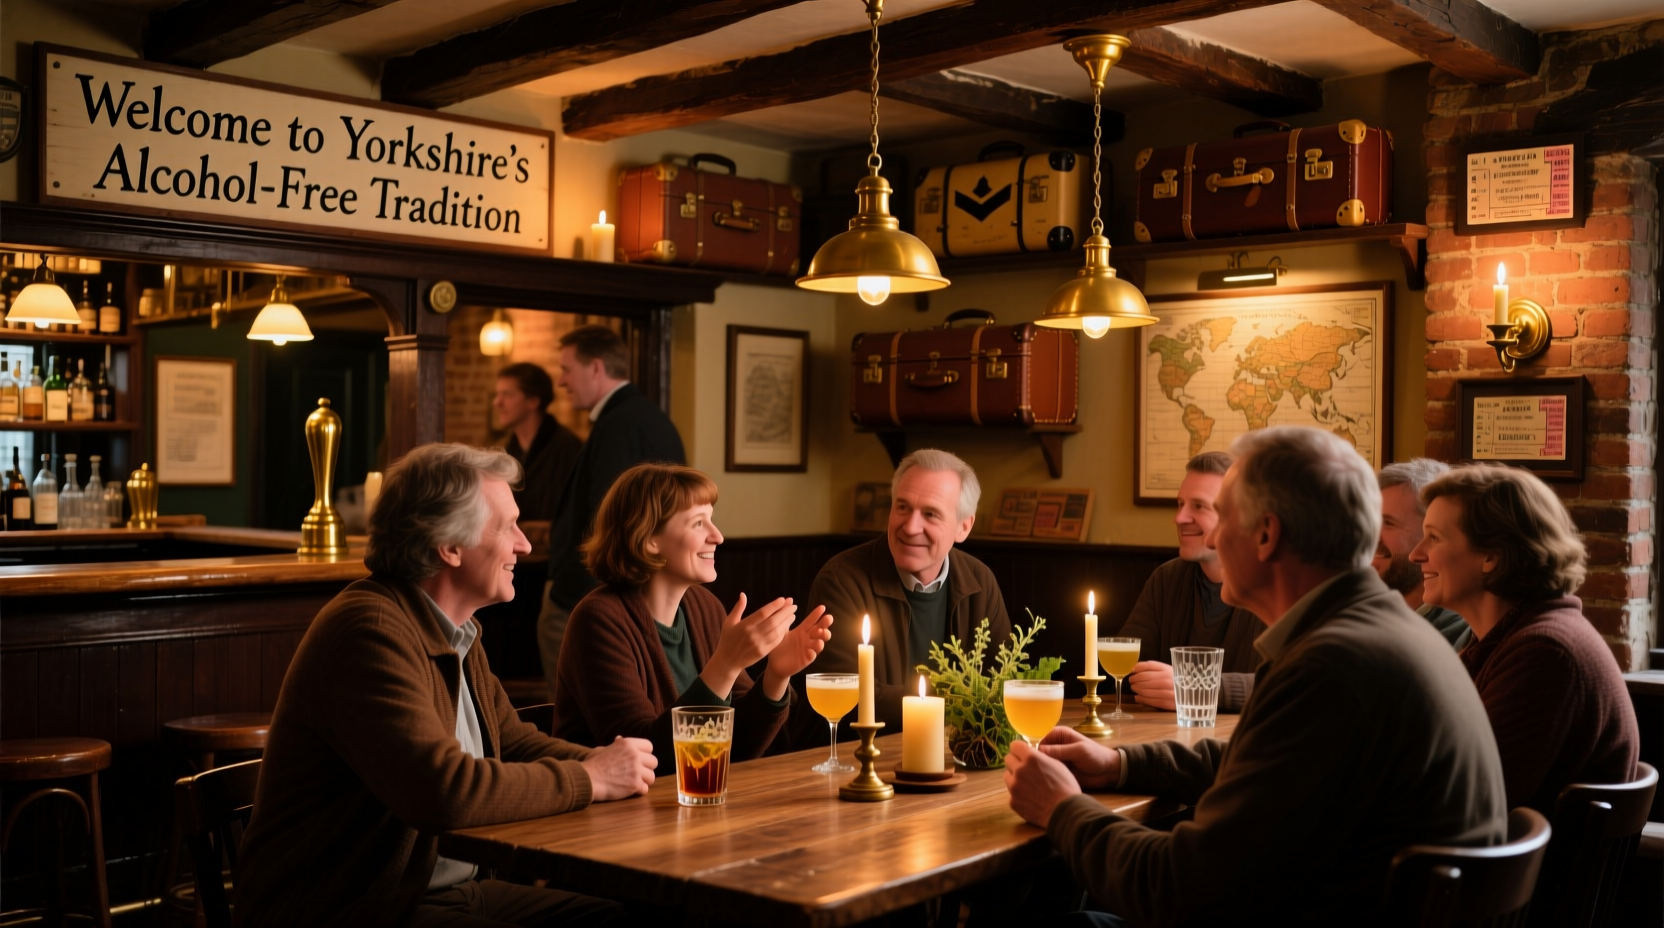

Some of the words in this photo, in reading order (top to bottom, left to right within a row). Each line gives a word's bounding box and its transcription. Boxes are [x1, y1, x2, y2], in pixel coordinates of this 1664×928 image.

[74, 72, 272, 147] Welcome
[287, 116, 325, 154] to
[339, 115, 530, 183] Yorkshire's
[92, 142, 359, 215] Alcohol-Free
[370, 176, 521, 234] Tradition
